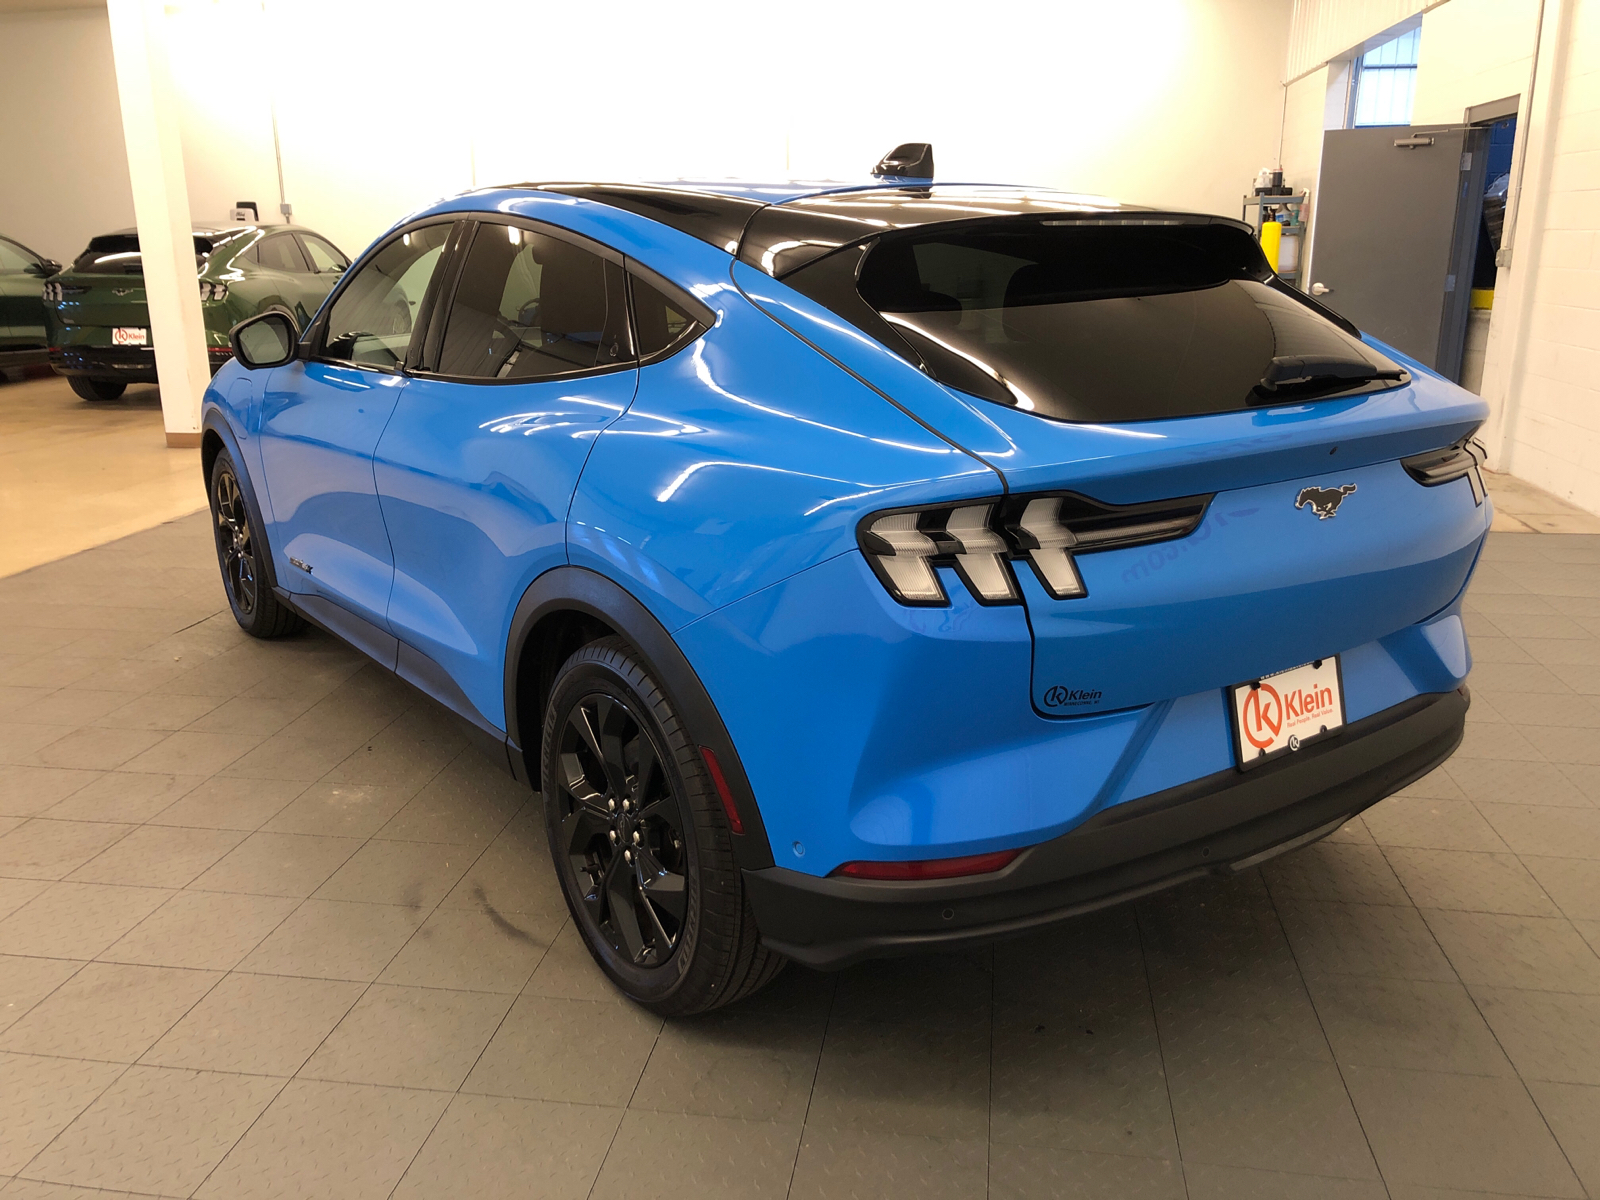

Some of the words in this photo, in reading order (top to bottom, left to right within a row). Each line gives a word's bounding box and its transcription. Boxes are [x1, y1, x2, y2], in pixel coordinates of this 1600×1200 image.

[1069, 689, 1102, 700] Klein
[1284, 683, 1333, 721] Klein
[541, 705, 557, 794] MICHELIN
